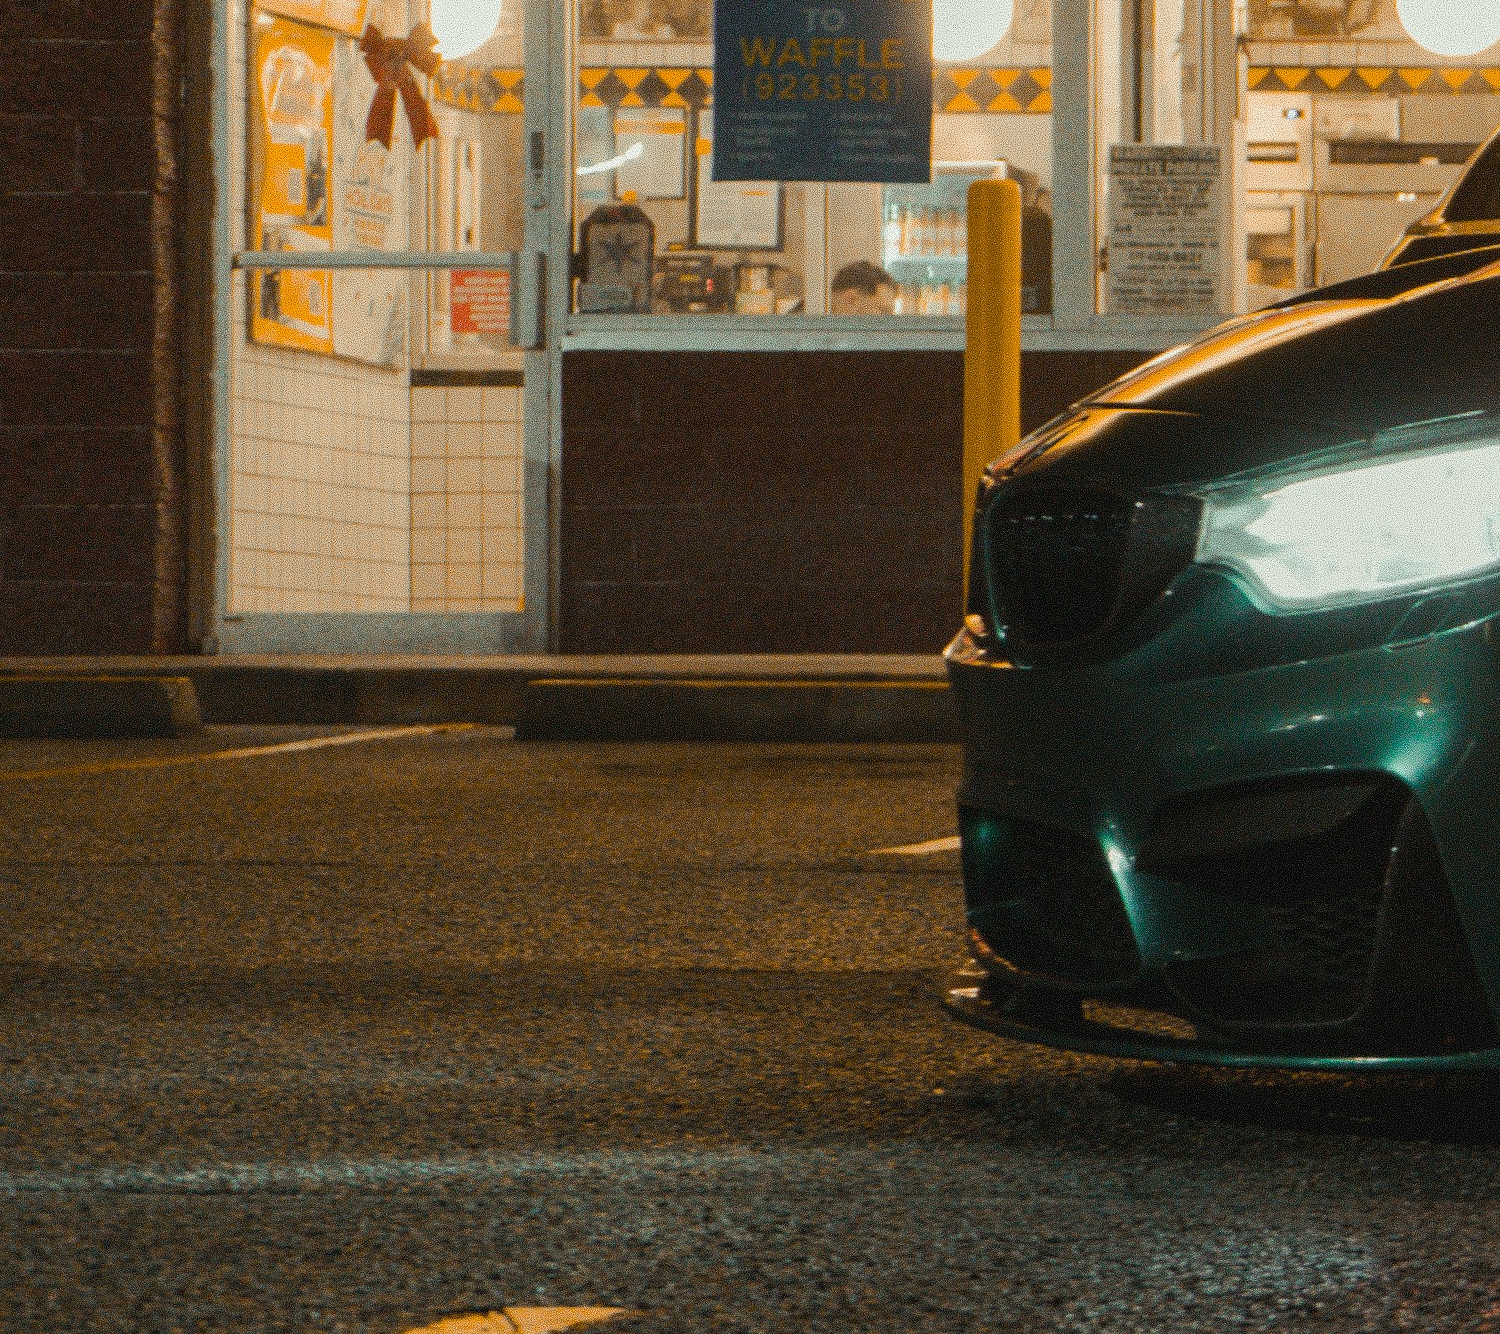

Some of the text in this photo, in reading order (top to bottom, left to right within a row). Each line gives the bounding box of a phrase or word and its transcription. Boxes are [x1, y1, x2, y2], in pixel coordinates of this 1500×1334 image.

[802, 8, 846, 32] TO
[740, 36, 905, 69] WAFFLE
[741, 72, 903, 104] (923353)
